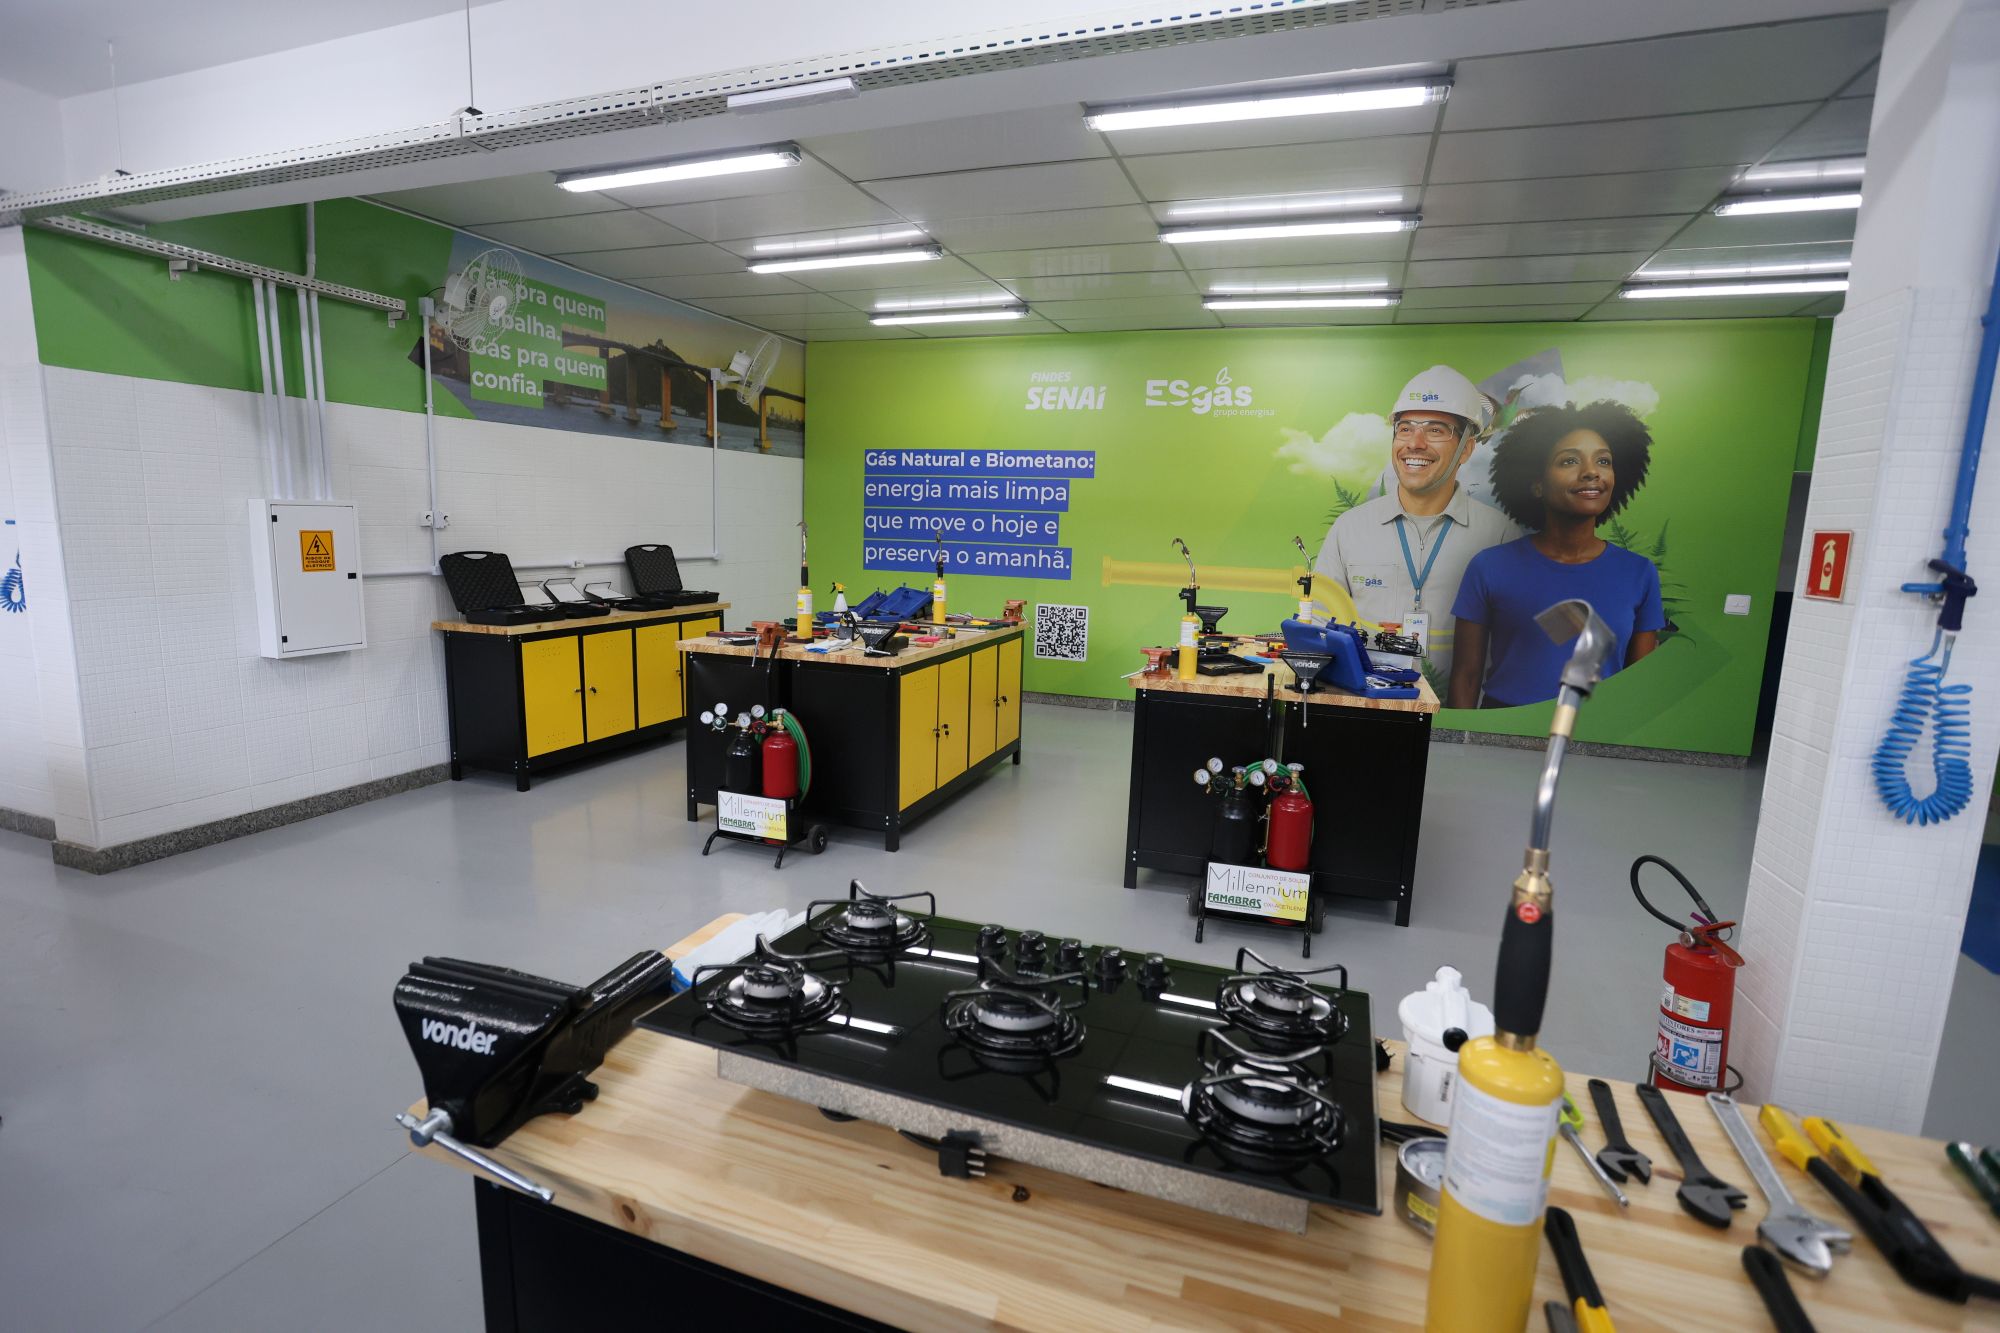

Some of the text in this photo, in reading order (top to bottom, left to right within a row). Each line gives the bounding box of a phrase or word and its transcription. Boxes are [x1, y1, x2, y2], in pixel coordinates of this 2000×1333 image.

[515, 282, 547, 306] pra
[553, 294, 605, 322] quem
[517, 347, 549, 368] pra
[554, 356, 606, 379] quem
[471, 370, 543, 397] confia.
[1030, 371, 1072, 383] FINDES
[1213, 409, 1238, 418] grupo
[865, 452, 1094, 469] Gás Natural e Biometano:
[865, 479, 1067, 505] energia mais limpa
[865, 514, 1058, 538] que move o hoje e
[865, 546, 1070, 569] preserva o amanhã.
[718, 794, 786, 822] Millennium
[719, 816, 756, 831] FAMABRAS
[1207, 865, 1308, 900] Millennium
[1207, 892, 1262, 909] FAMABRAS
